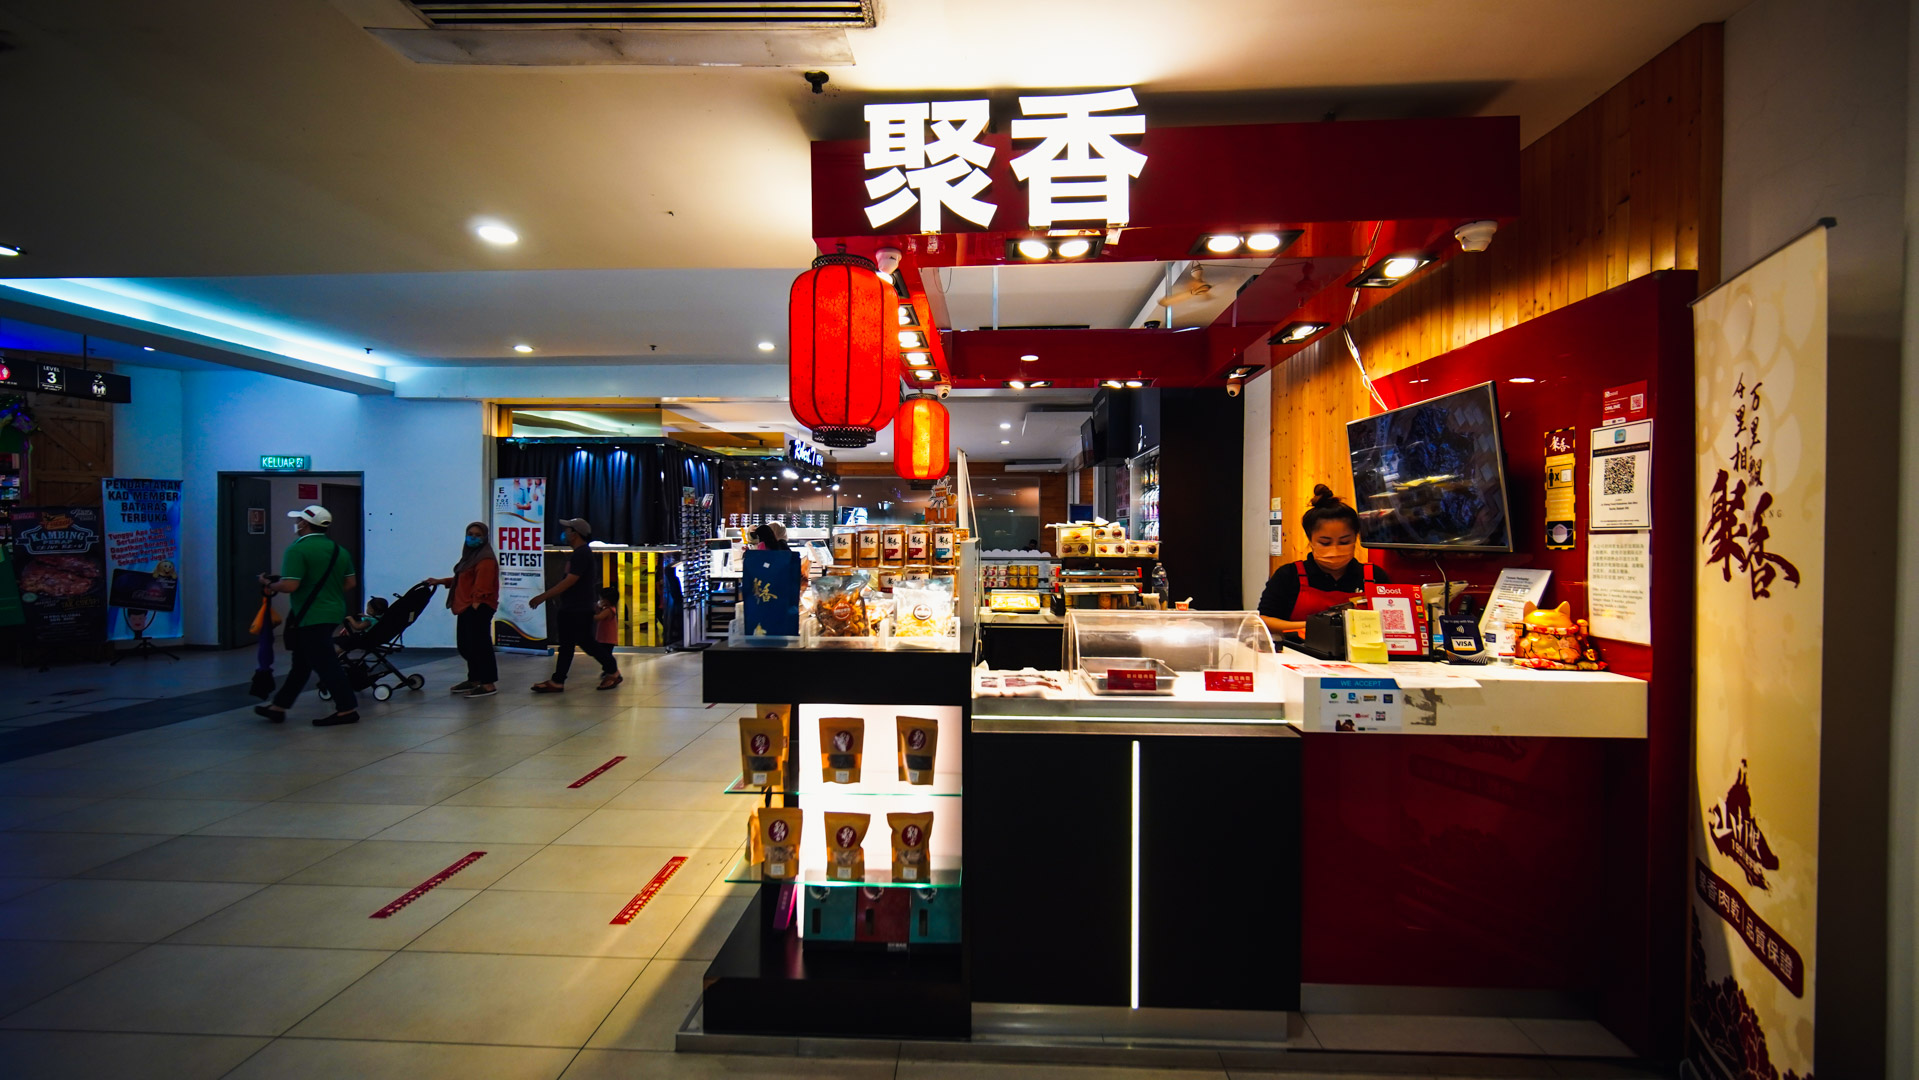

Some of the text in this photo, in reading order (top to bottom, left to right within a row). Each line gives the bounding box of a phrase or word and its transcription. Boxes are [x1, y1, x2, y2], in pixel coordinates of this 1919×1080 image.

[864, 87, 1149, 234] 聚香
[43, 365, 60, 373] LEVEL
[46, 371, 57, 384] 3
[262, 456, 295, 468] KELUAR
[106, 480, 181, 490] PENDAFTARAN
[108, 491, 179, 501] KAD MEMBER
[121, 502, 167, 512] BATARAS
[121, 513, 168, 522] TERBUKA
[31, 531, 85, 541] KAMBING
[499, 527, 541, 550] FREE
[499, 553, 542, 567] EYE TEST
[1376, 586, 1402, 595] Boost
